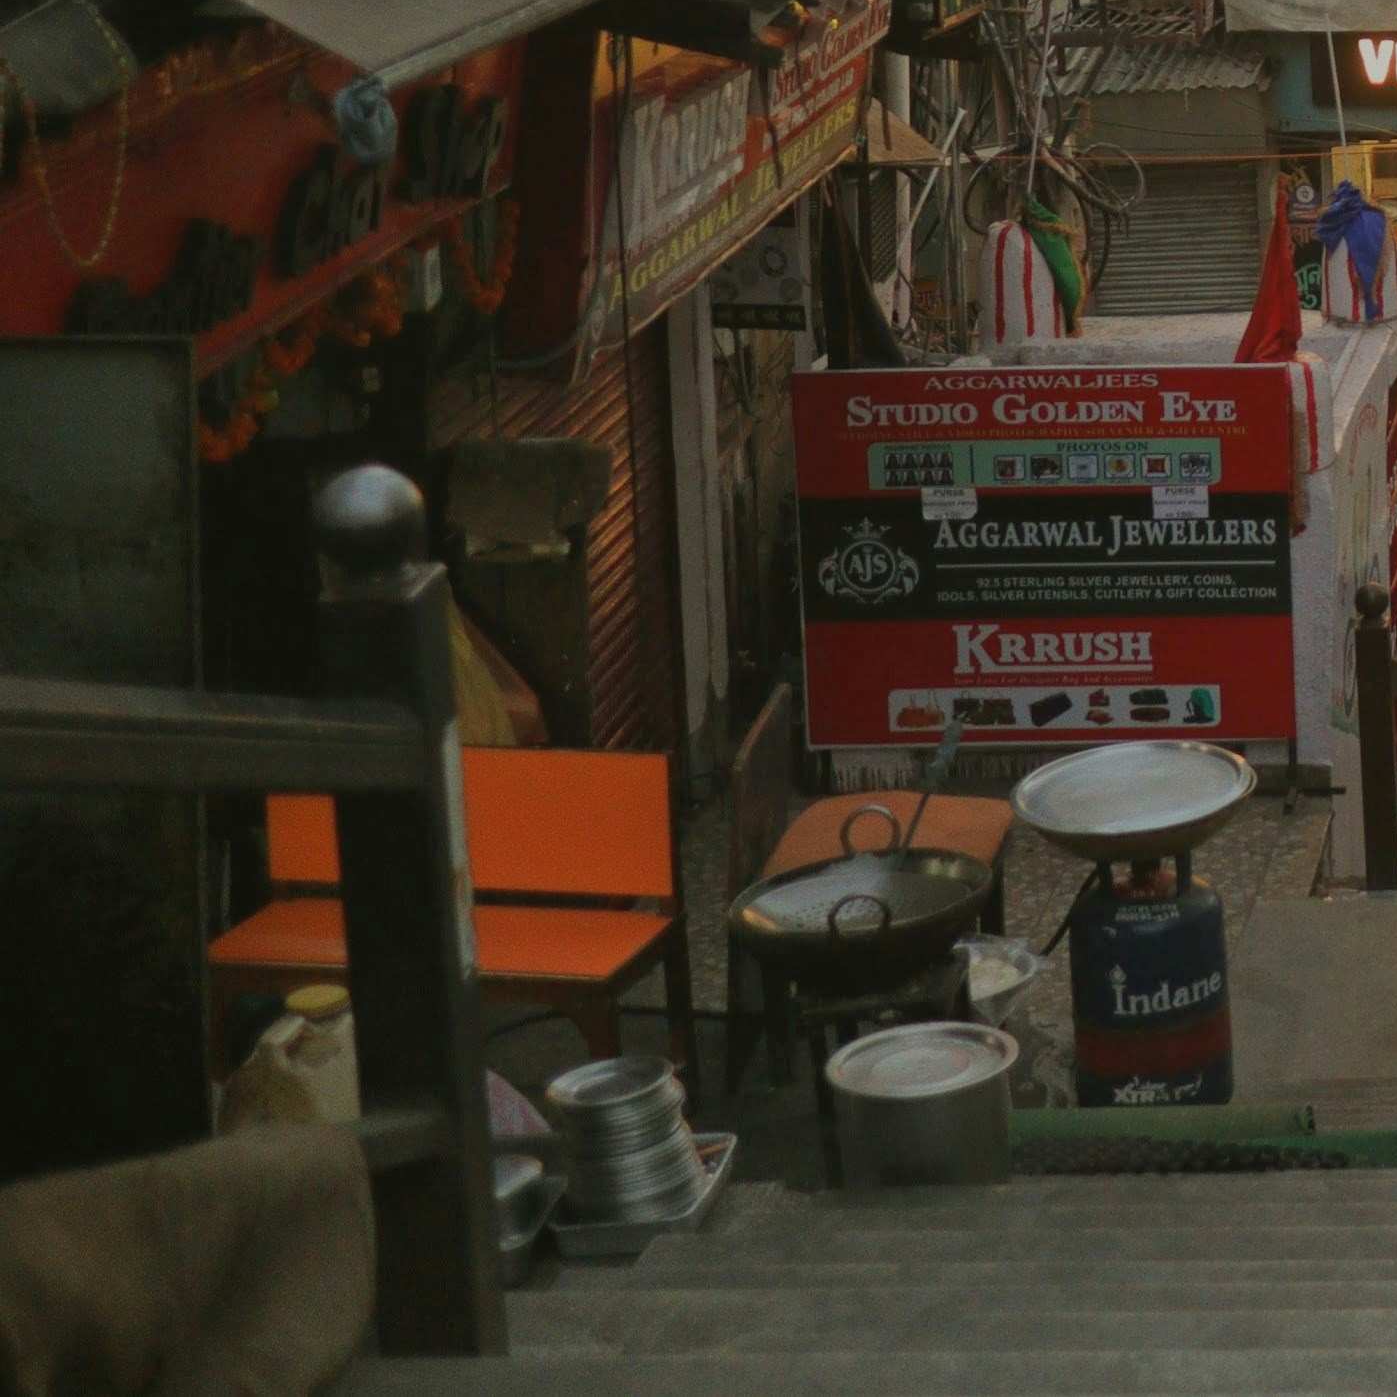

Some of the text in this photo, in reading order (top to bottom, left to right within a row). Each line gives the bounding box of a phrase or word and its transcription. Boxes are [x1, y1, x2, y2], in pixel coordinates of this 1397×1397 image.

[924, 373, 1159, 391] AGGARWALJEES
[846, 391, 1237, 427] STUDIO GOLDEN EYE
[1056, 441, 1149, 453] PHOTOS ON
[934, 514, 1277, 557] AGGARWAL JEWELLERS
[847, 552, 888, 584] AJS
[976, 577, 1001, 588] 92.5
[1003, 576, 1065, 588] STERLING
[1068, 575, 1111, 587] SILVER
[981, 590, 1026, 602] SILVER
[1095, 588, 1151, 600] CUTLERY
[1154, 588, 1163, 599] &
[1166, 588, 1194, 599] GIFT
[1197, 587, 1277, 599] COLLECTION
[952, 624, 1153, 675] KRRUSH
[1112, 970, 1222, 1015] Indane
